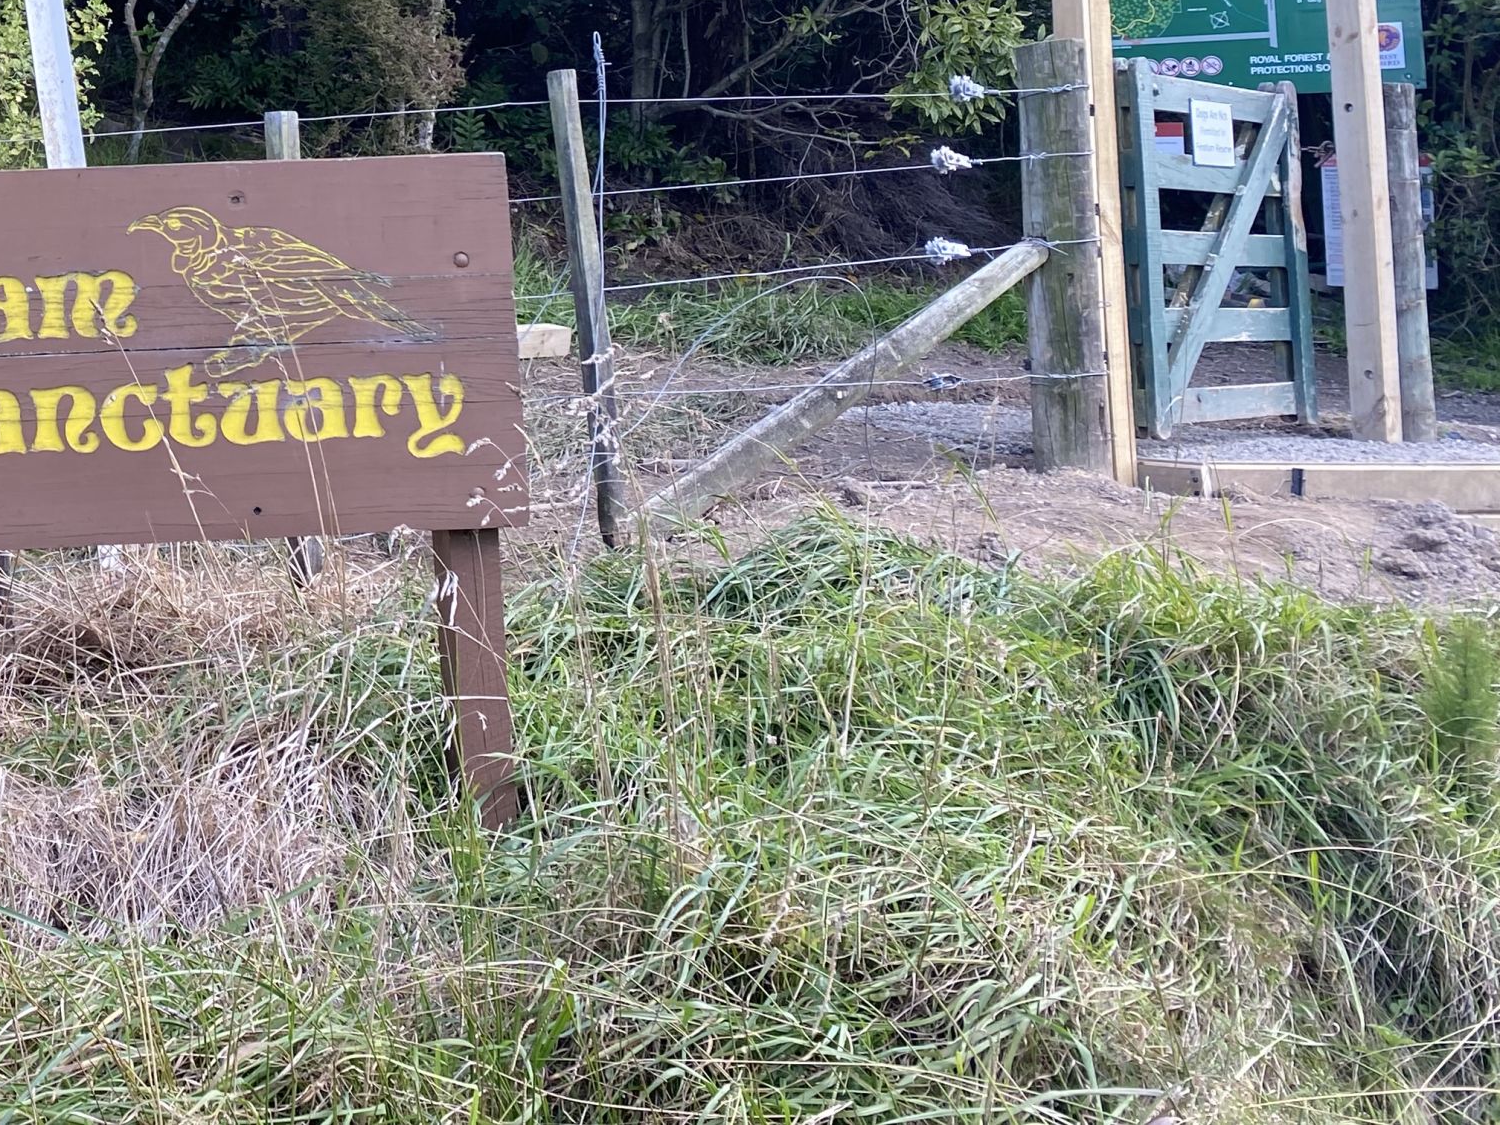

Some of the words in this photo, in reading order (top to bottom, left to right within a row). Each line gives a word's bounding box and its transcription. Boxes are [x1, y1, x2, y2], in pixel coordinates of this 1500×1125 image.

[1250, 55, 1281, 64] ROYAL
[1284, 53, 1323, 62] FOREST
[1250, 65, 1314, 75] PROTECTION
[1316, 63, 1331, 73] SO
